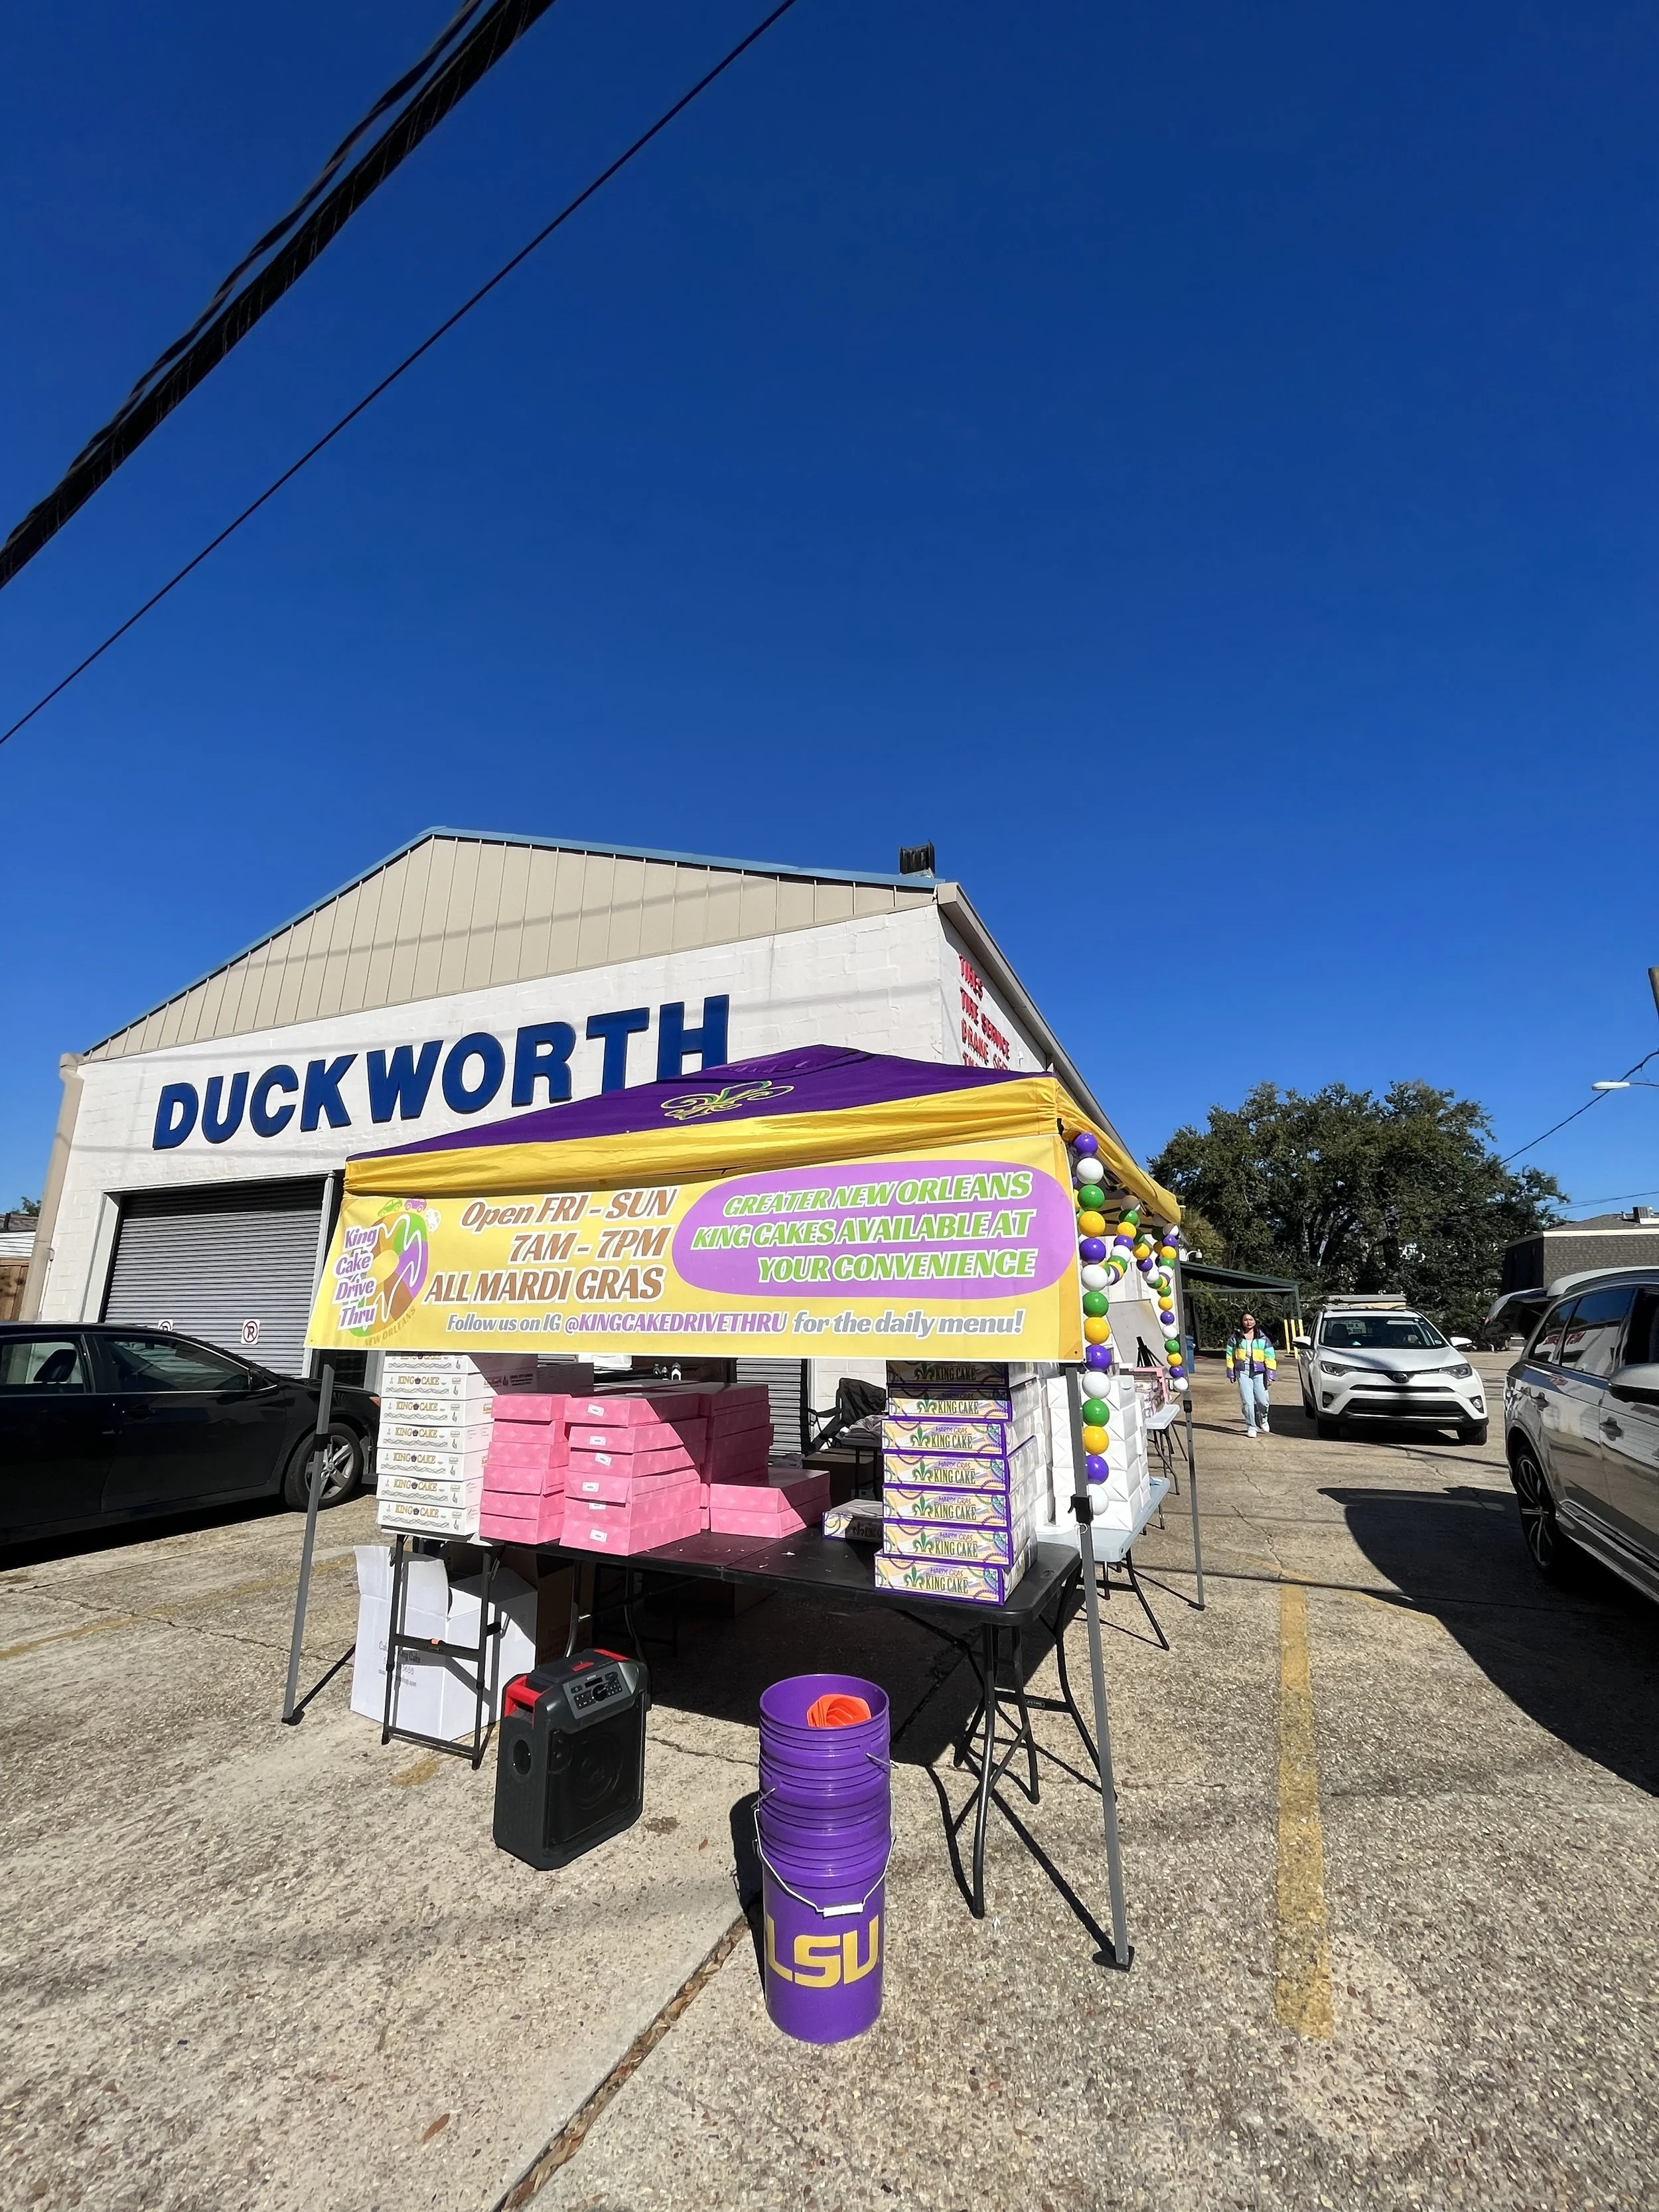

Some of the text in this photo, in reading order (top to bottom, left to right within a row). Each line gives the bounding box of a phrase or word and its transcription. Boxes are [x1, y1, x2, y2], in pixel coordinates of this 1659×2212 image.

[962, 1018, 989, 1066] BRAKE
[152, 994, 730, 1151] DUCKWORTH
[725, 1173, 1031, 1215] GREATER NEW ORLEANS
[462, 1202, 534, 1232] Open
[535, 1195, 589, 1222] FRI
[605, 1189, 677, 1218] SUN
[345, 1228, 377, 1248] King
[693, 1211, 1034, 1248] KING CAKES AVAILABLE AT
[510, 1232, 577, 1261] 7AM
[597, 1227, 672, 1258] 7PM
[336, 1252, 371, 1275] Cake
[759, 1251, 1036, 1281] YOUR CONVENIENCE
[335, 1278, 374, 1300] Drive
[424, 1268, 664, 1301] ALL MARDI GRAS
[340, 1304, 375, 1327] Thru
[447, 1310, 1024, 1338] Follow us on IG @KINGCAKEDRIVETHRU for the daily menu!
[364, 1307, 416, 1347] NEW ORLEANS
[397, 1376, 439, 1385] KING CAKE
[935, 1367, 976, 1380] KING CAKE
[419, 1402, 438, 1411] CAKE
[938, 1401, 979, 1414] KING CAKE
[395, 1428, 438, 1438] KING CAKE
[931, 1434, 972, 1449] KING CAKE
[393, 1453, 436, 1464] KING CAKE
[394, 1479, 437, 1492] KING CAKE
[934, 1469, 975, 1484] KING CAKE
[395, 1504, 439, 1518] KING CAKE
[934, 1505, 976, 1520] KING CAKE
[935, 1540, 978, 1557] KING CAKE
[926, 1576, 968, 1593] KING CAKE
[767, 1913, 879, 1988] LSU
